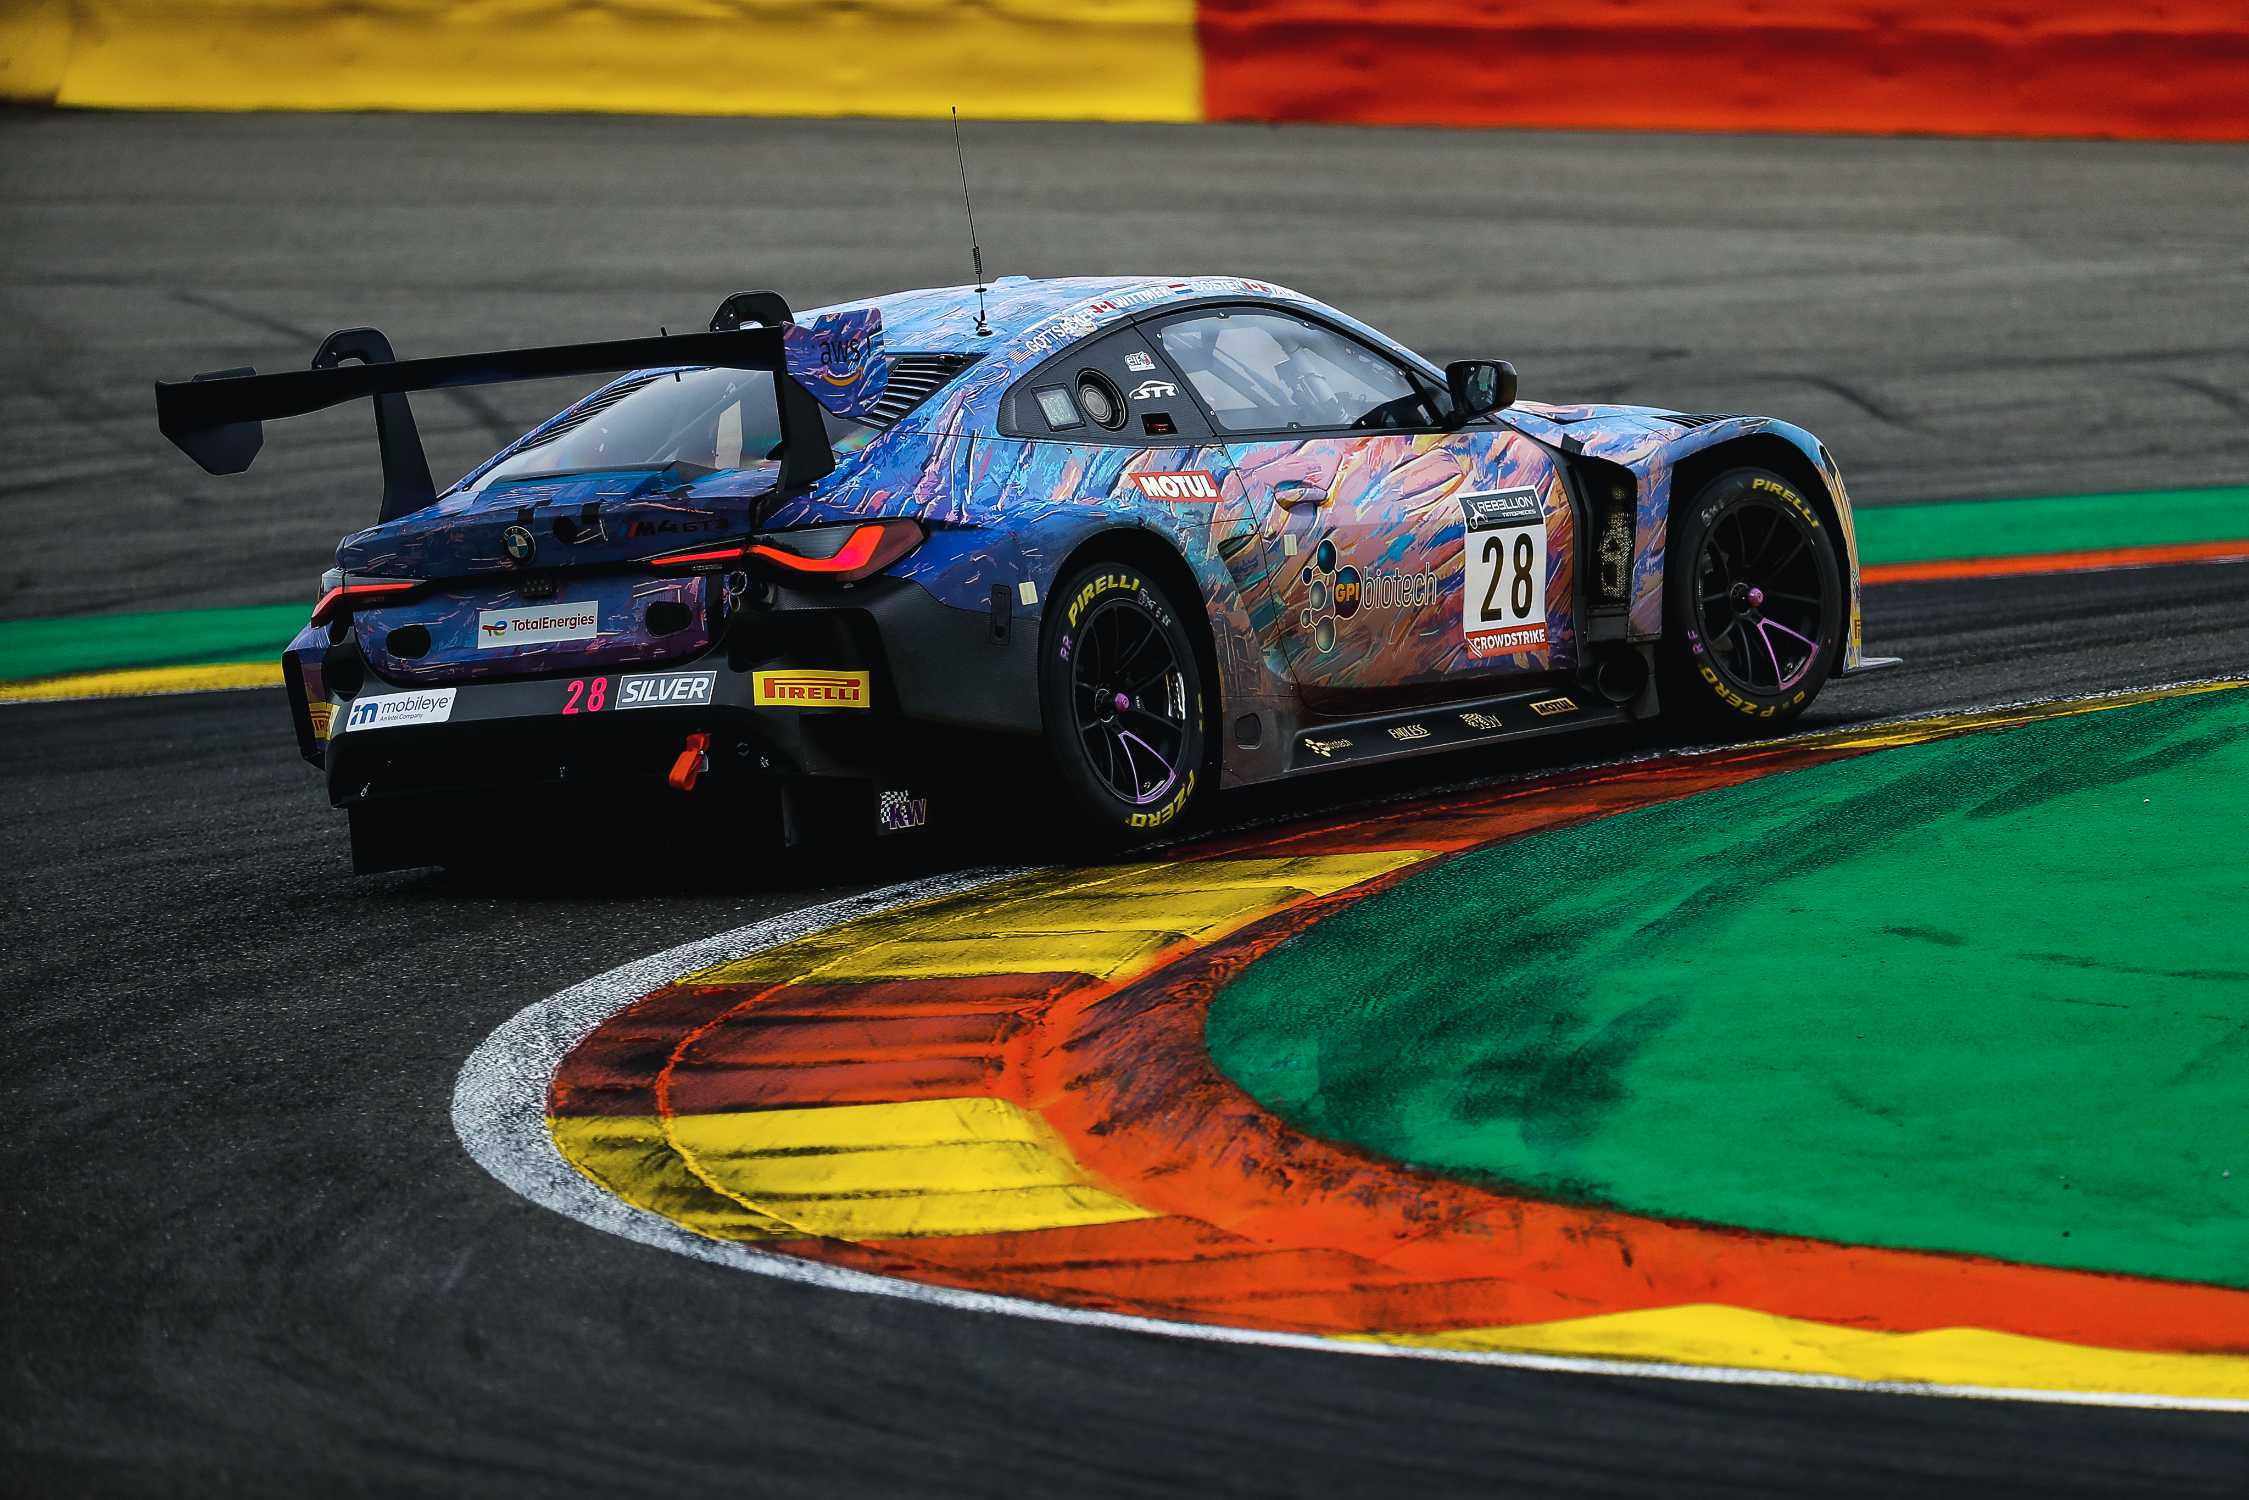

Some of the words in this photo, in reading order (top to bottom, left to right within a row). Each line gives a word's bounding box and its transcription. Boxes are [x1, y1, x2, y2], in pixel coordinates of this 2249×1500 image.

[1025, 307, 1098, 352] GOTTSACKER
[1113, 286, 1175, 308] WITTMER
[1138, 474, 1218, 498] MOTUL
[1477, 496, 1534, 514] REBELLION
[1752, 477, 1820, 529] PIRELLI
[1335, 582, 1360, 603] GPI
[1361, 562, 1437, 610] biotech
[1480, 532, 1534, 622] 28
[1068, 574, 1141, 628] PIRELLI
[512, 613, 595, 632] TotalEnergies
[1473, 628, 1546, 651] CROWDSTRIKE
[562, 677, 608, 715] 28
[622, 677, 709, 703] SILVER
[763, 677, 860, 701] PIRELLI
[381, 695, 449, 713] mobileye
[1536, 699, 1575, 714] MOTUL
[1387, 723, 1429, 739] ENDLESS
